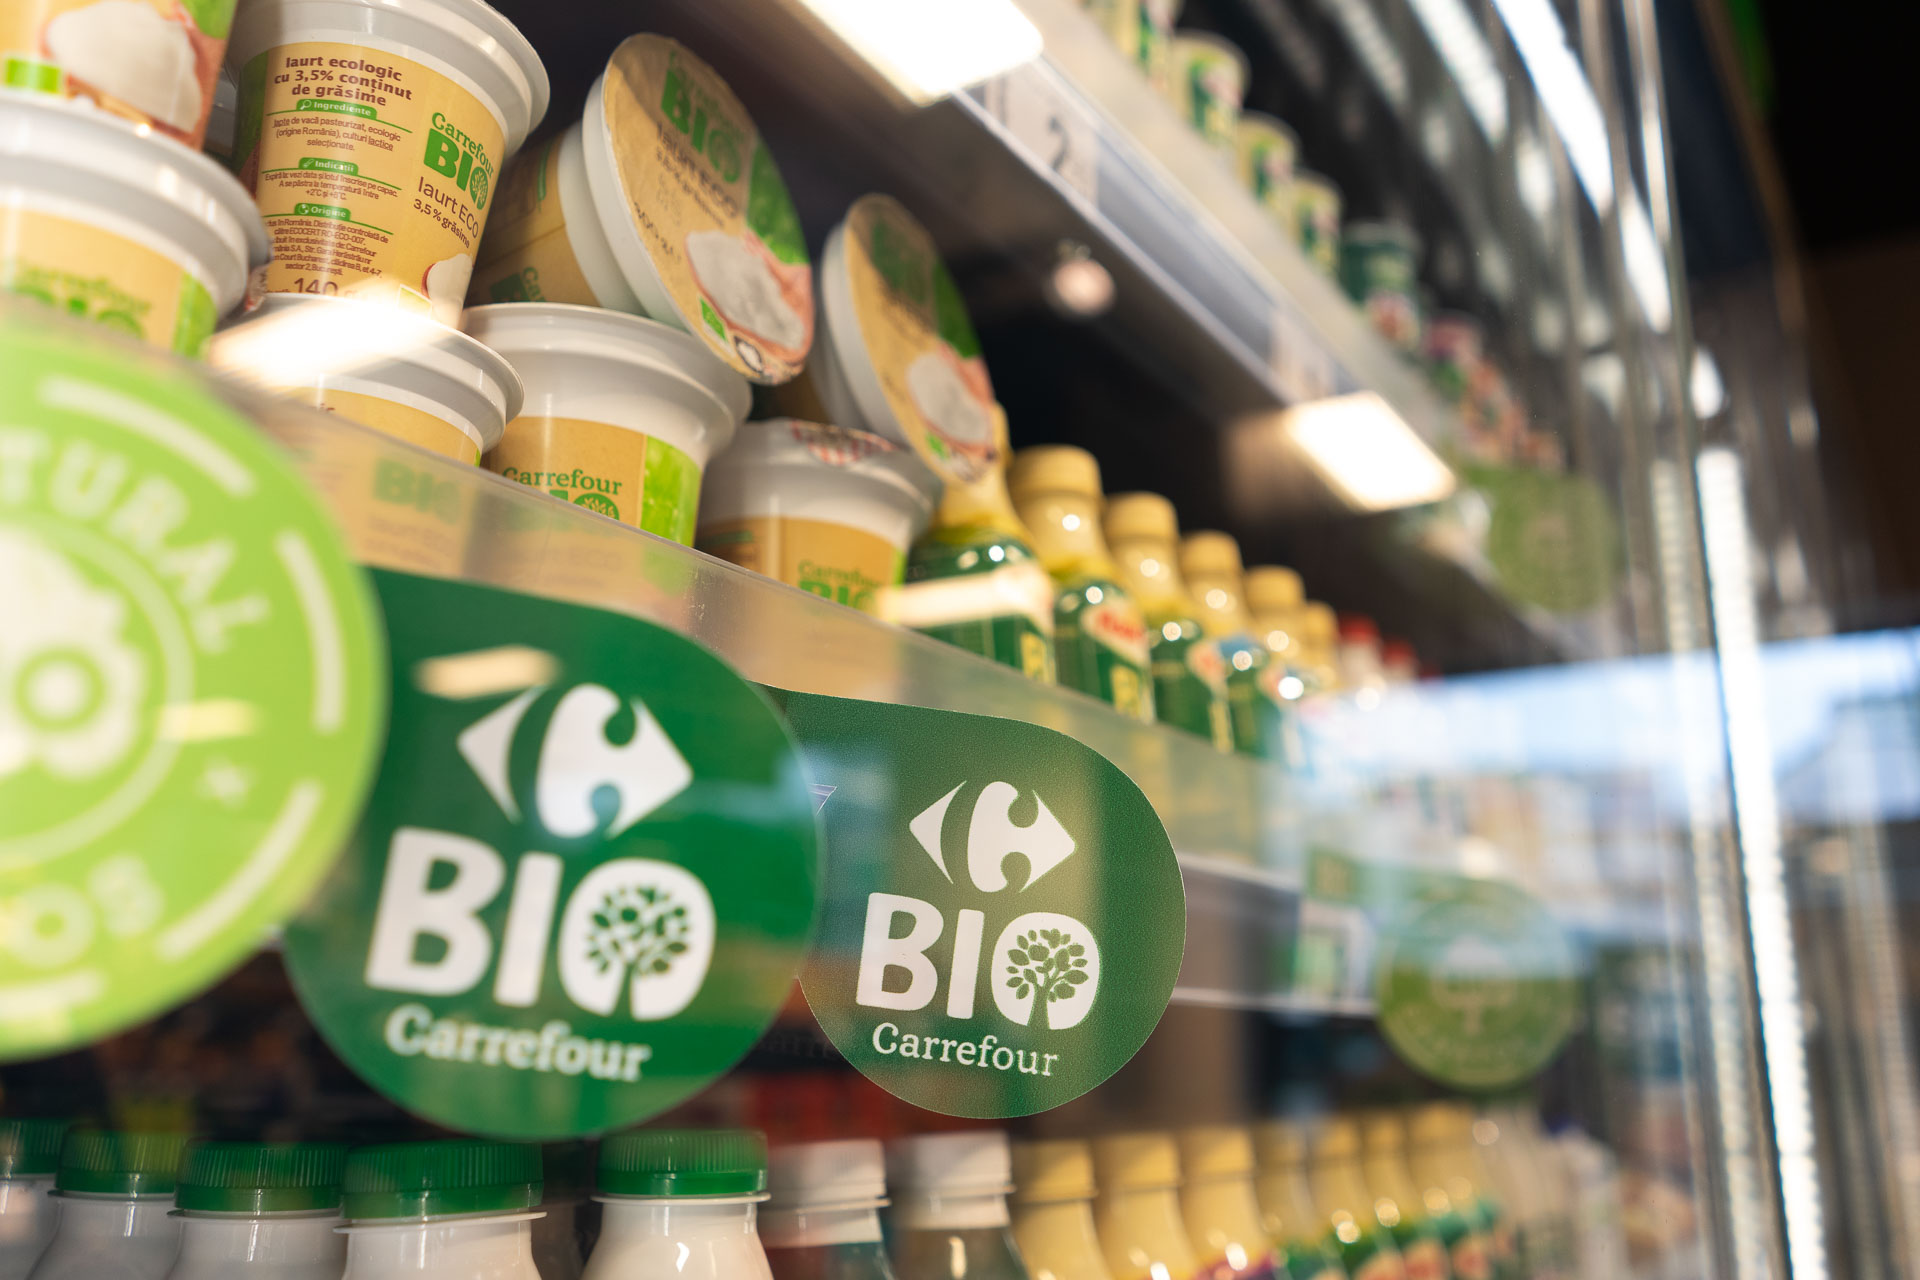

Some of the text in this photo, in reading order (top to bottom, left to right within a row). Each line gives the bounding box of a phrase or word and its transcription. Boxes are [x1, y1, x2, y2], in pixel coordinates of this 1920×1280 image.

[286, 57, 402, 81] Iaurt ecologic
[274, 70, 412, 100] cu 3,5% conținut
[292, 84, 387, 106] de grăsime
[314, 101, 372, 116] Ingrediente
[276, 127, 301, 138] (origine
[368, 136, 394, 151] lactice
[291, 117, 300, 125] de
[320, 118, 367, 132] pasteurizat,
[368, 126, 401, 141] ecologic
[661, 69, 741, 184] BIO
[432, 112, 494, 178] Carrefour
[423, 128, 488, 210] BIO
[367, 181, 377, 189] pe
[311, 206, 346, 218] Origine
[418, 176, 479, 238] Iaurt ECO
[441, 217, 470, 249] grăsime
[502, 466, 623, 495] Carrefour
[364, 826, 717, 1022] BIO
[855, 892, 1101, 1031] BIO
[383, 1002, 652, 1082] Carrefour
[872, 1021, 1059, 1077] Carrefour
